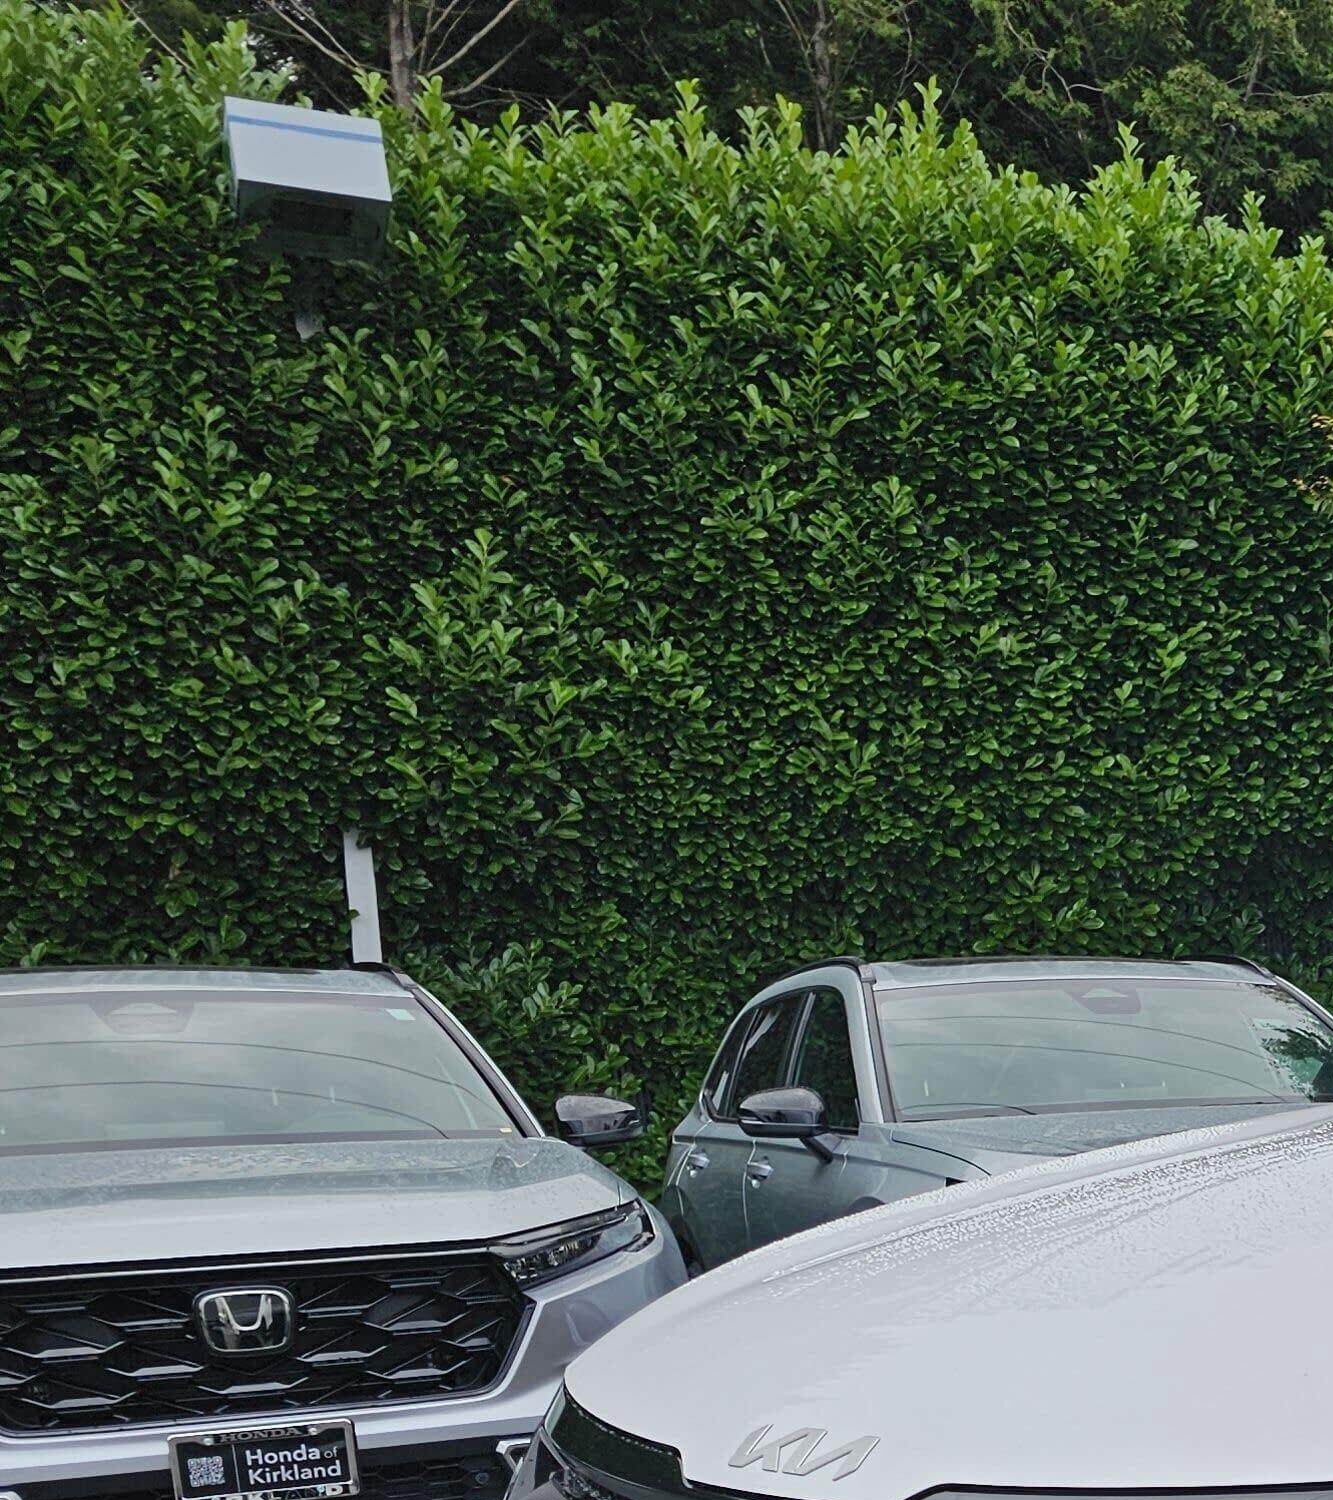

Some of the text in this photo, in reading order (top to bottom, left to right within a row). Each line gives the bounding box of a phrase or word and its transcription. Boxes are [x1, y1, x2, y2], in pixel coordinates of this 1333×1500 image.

[219, 1427, 303, 1443] HONDA
[245, 1444, 339, 1466] Honda of
[248, 1460, 342, 1485] Kirkland
